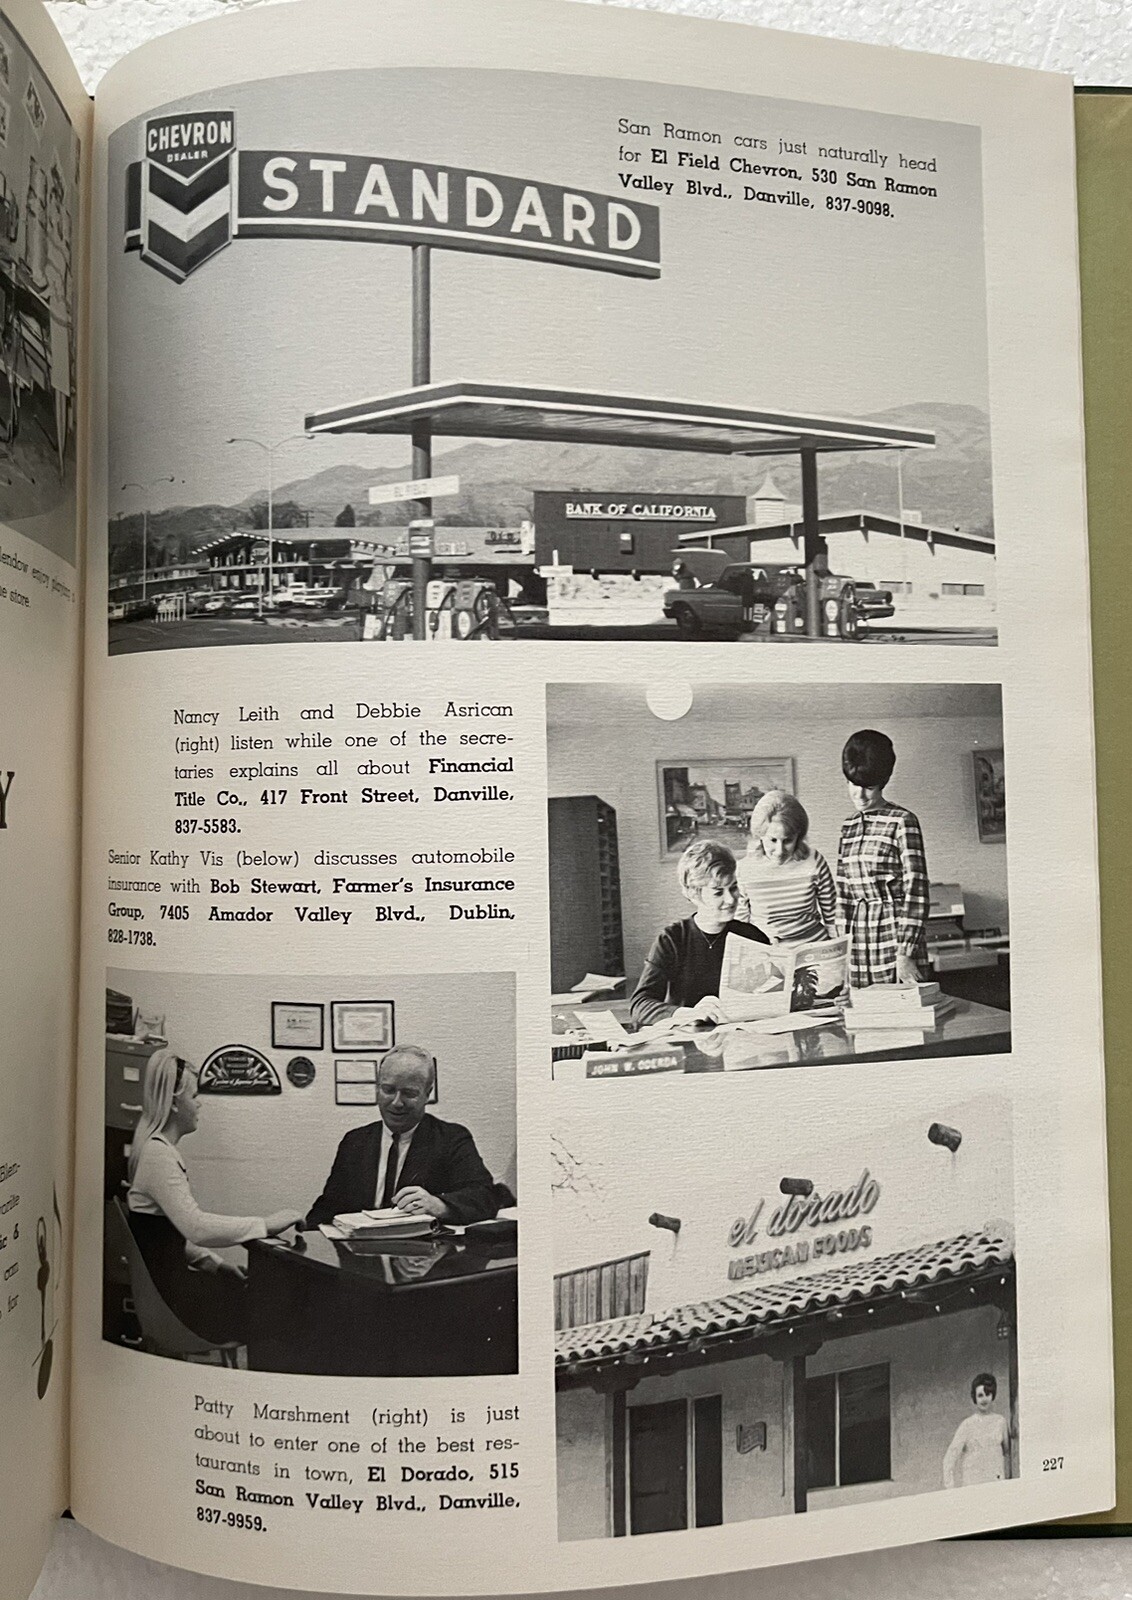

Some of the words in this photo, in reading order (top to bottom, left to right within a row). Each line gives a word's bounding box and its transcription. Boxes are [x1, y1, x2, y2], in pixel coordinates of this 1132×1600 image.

[148, 121, 231, 152] CHEVRON
[618, 118, 651, 136] San
[663, 123, 721, 144] Ramon
[734, 136, 767, 150] cars
[779, 138, 807, 155] just
[817, 147, 888, 168] naturally
[899, 153, 937, 172] head
[167, 150, 208, 162] DEALER
[619, 146, 641, 162] for
[651, 148, 668, 164] El
[678, 151, 720, 171] Field
[729, 157, 802, 181] Chevron,
[812, 168, 837, 184] 530
[846, 172, 877, 189] San
[884, 177, 937, 197] Ramon
[262, 157, 642, 251] STANDARD
[618, 173, 674, 195] Valley
[686, 180, 732, 199] Blvd.,
[744, 186, 814, 209] Danville,
[826, 196, 894, 218] 837-9098.
[565, 503, 602, 515] BANK
[608, 503, 627, 516] OF
[632, 504, 717, 518] CALIFORNIA
[10, 590, 31, 608] store.
[174, 709, 220, 726] Nancy
[239, 706, 279, 722] Leith
[300, 704, 334, 720] and
[356, 702, 421, 718] Debbie
[444, 702, 513, 717] Asrican
[175, 736, 219, 755] (right)
[231, 735, 274, 750] listen
[285, 732, 332, 748] while
[345, 736, 378, 747] one
[390, 730, 406, 746] of
[419, 730, 447, 745] the
[460, 734, 513, 745] secre-
[174, 765, 214, 779] taries
[229, 762, 298, 781] explains
[316, 760, 338, 775] all
[357, 759, 410, 775] about
[429, 757, 514, 774] Financial
[174, 792, 205, 806] Title
[217, 791, 247, 806] Co.,
[260, 790, 287, 805] 417
[300, 789, 348, 804] Front
[361, 788, 419, 803] Street,
[433, 786, 514, 802] Danville,
[175, 818, 241, 834] 837-5583.
[109, 849, 141, 864] Senior
[150, 850, 189, 868] Kathy
[200, 851, 223, 866] Vis
[237, 850, 299, 868] (below)
[314, 850, 397, 865] discusses
[412, 847, 515, 864] automobile
[108, 876, 161, 892] insurance
[170, 878, 200, 893] with
[210, 877, 240, 894] Bob
[251, 878, 321, 894] Stewart,
[425, 877, 515, 892] Insurance
[108, 902, 144, 921] Group,
[160, 905, 189, 920] 7405
[208, 907, 273, 922] Amador
[294, 906, 352, 925] Valley
[375, 906, 425, 922] Blvd.,
[449, 904, 515, 920] Dublin,
[108, 928, 156, 946] 828-1738.
[728, 1199, 765, 1247] el
[767, 1168, 880, 1236] dorado
[728, 1241, 810, 1280] MEXICAN
[813, 1225, 873, 1258] FOODS
[195, 1395, 234, 1418] Patty
[254, 1403, 349, 1424] Marshment
[372, 1408, 428, 1427] (right)
[451, 1408, 465, 1423] is
[486, 1406, 519, 1424] just
[195, 1425, 240, 1444] about
[250, 1433, 265, 1447] to
[274, 1436, 318, 1451] enter
[328, 1441, 360, 1453] one
[371, 1437, 387, 1453] of
[398, 1437, 426, 1453] the
[436, 1437, 475, 1453] best
[486, 1439, 519, 1451] res-
[196, 1453, 260, 1475] taurants
[274, 1463, 290, 1479] in
[305, 1466, 352, 1485] town,
[367, 1466, 386, 1482] El
[401, 1465, 474, 1482] Dorado,
[489, 1462, 519, 1480] 515
[1042, 1456, 1064, 1471] 227
[196, 1479, 225, 1498] San
[236, 1486, 294, 1507] Ramon
[305, 1493, 364, 1514] Valley
[376, 1495, 426, 1512] Blvd.,
[439, 1492, 520, 1510] Danville,
[197, 1506, 267, 1532] 837-9959.
